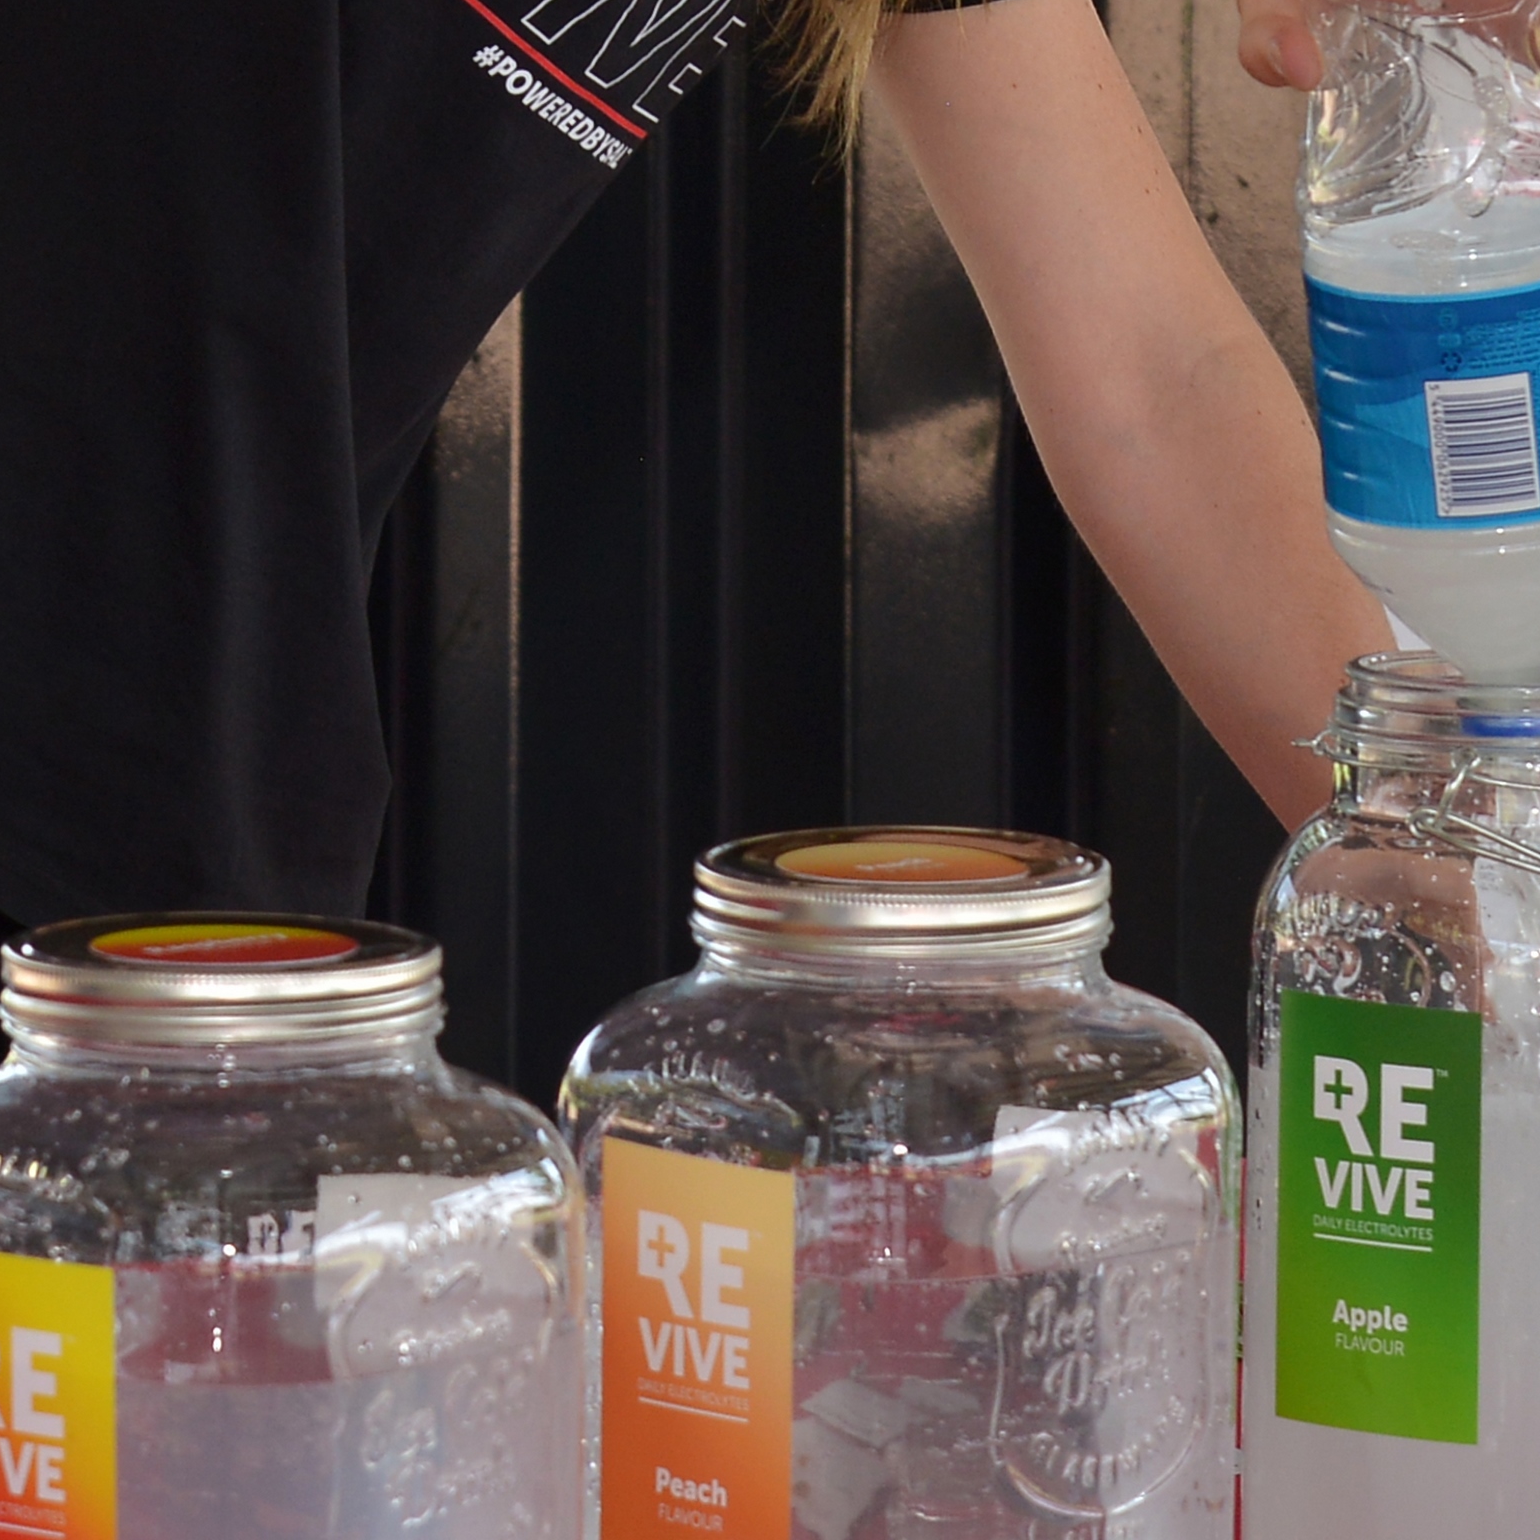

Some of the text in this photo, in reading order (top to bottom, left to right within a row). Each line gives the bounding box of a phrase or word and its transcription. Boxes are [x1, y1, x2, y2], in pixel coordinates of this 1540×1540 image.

[1314, 1055, 1435, 1163] RE
[1314, 1157, 1434, 1220] VIVE
[1313, 1214, 1433, 1241] DAILY ELECTROLYTES
[637, 1209, 750, 1330] RE
[1333, 1299, 1408, 1334] Apple
[639, 1317, 750, 1390] VIVE
[1335, 1333, 1405, 1356] FLAVOUR
[655, 1466, 727, 1507] Peach
[658, 1502, 723, 1532] FLAVOUR
